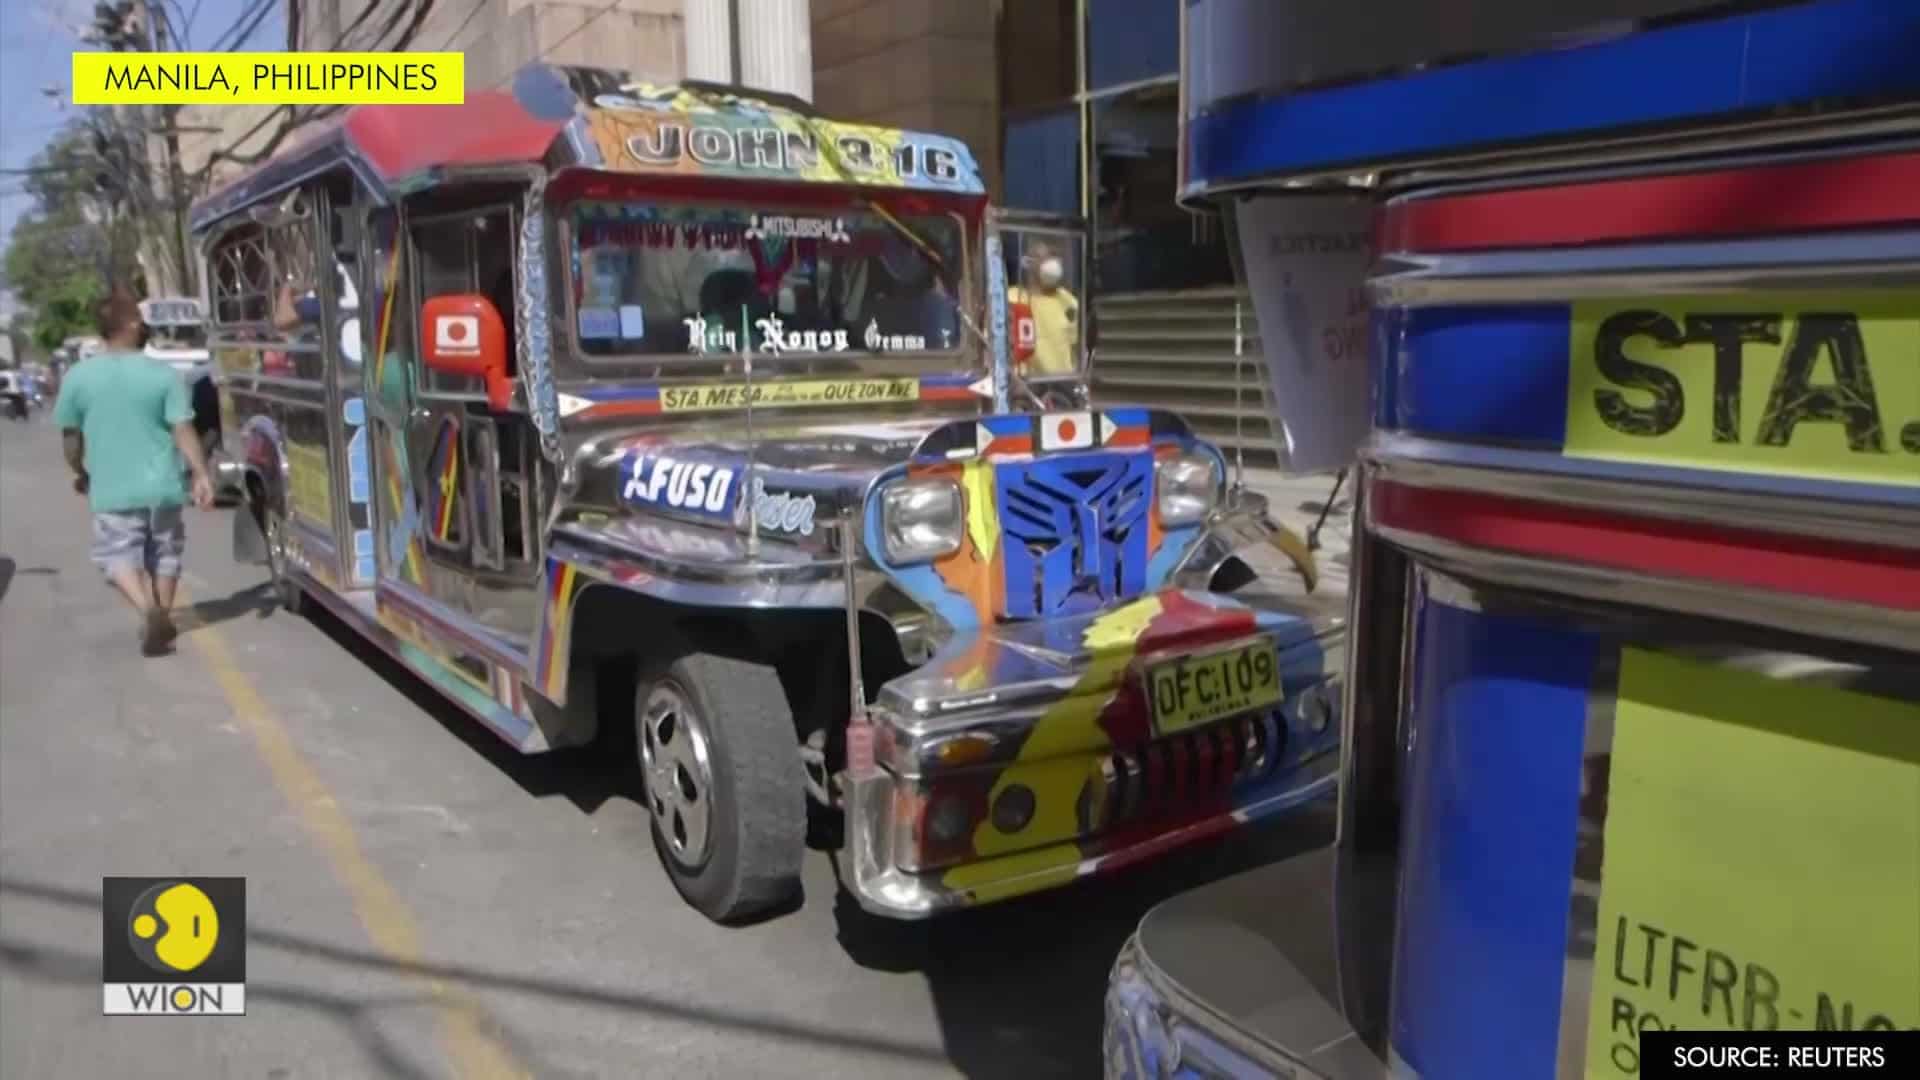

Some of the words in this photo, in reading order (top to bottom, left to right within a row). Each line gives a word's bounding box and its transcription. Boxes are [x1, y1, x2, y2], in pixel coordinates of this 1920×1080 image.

[627, 124, 820, 170] JOHN
[762, 214, 833, 239] MITSUBISHI
[706, 386, 763, 407] MESA
[823, 383, 885, 402] QUEZON
[1593, 308, 1920, 455] STA.
[648, 457, 734, 513] FUSO
